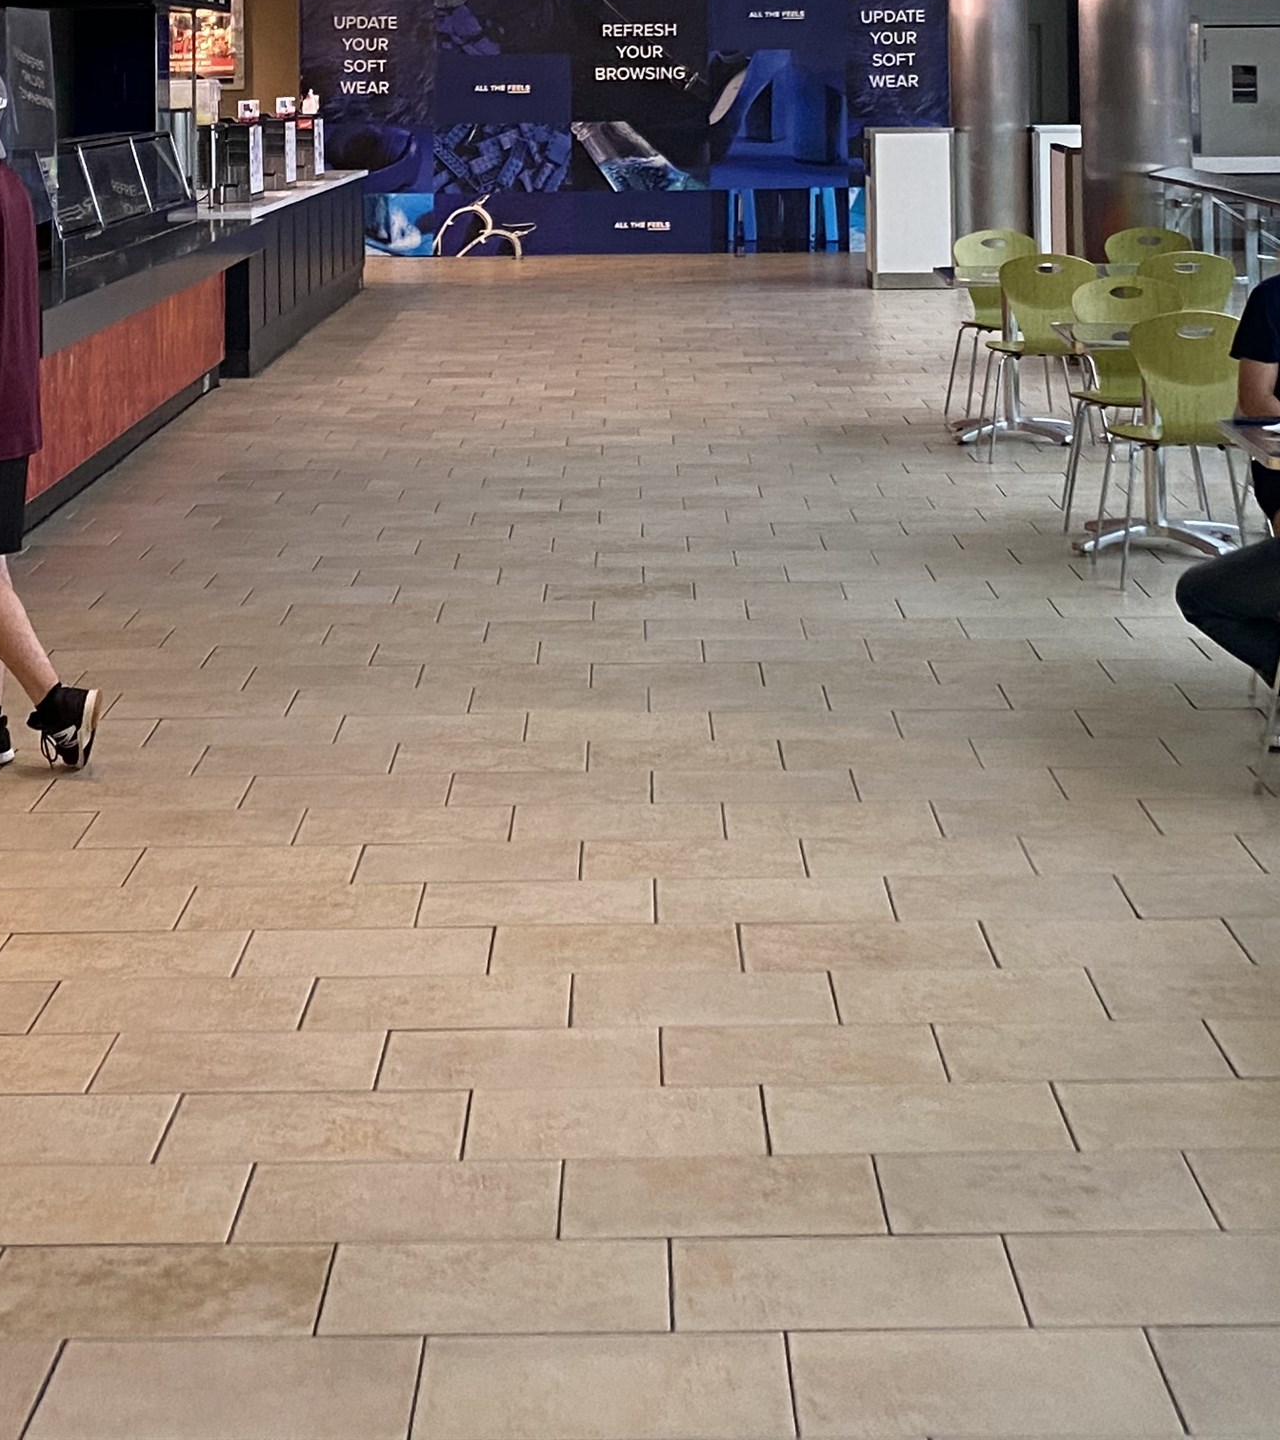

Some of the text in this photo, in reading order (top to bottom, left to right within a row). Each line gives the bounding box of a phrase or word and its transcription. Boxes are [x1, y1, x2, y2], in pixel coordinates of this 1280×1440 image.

[749, 11, 763, 19] ALL
[782, 10, 805, 20] FEELS
[861, 9, 926, 24] UPDATE
[333, 16, 398, 30] UPDATE
[602, 23, 677, 37] REFRESH
[342, 37, 389, 51] YOUR
[870, 31, 917, 45] YOUR
[615, 45, 663, 59] YOUR
[343, 59, 388, 73] SOFT
[872, 52, 916, 67] SOFT
[594, 66, 686, 81] BROWSING
[340, 81, 390, 94] WEAR
[869, 74, 919, 89] WEAR
[474, 84, 531, 94] ALL THE FEELS
[647, 221, 671, 231] FEELS
